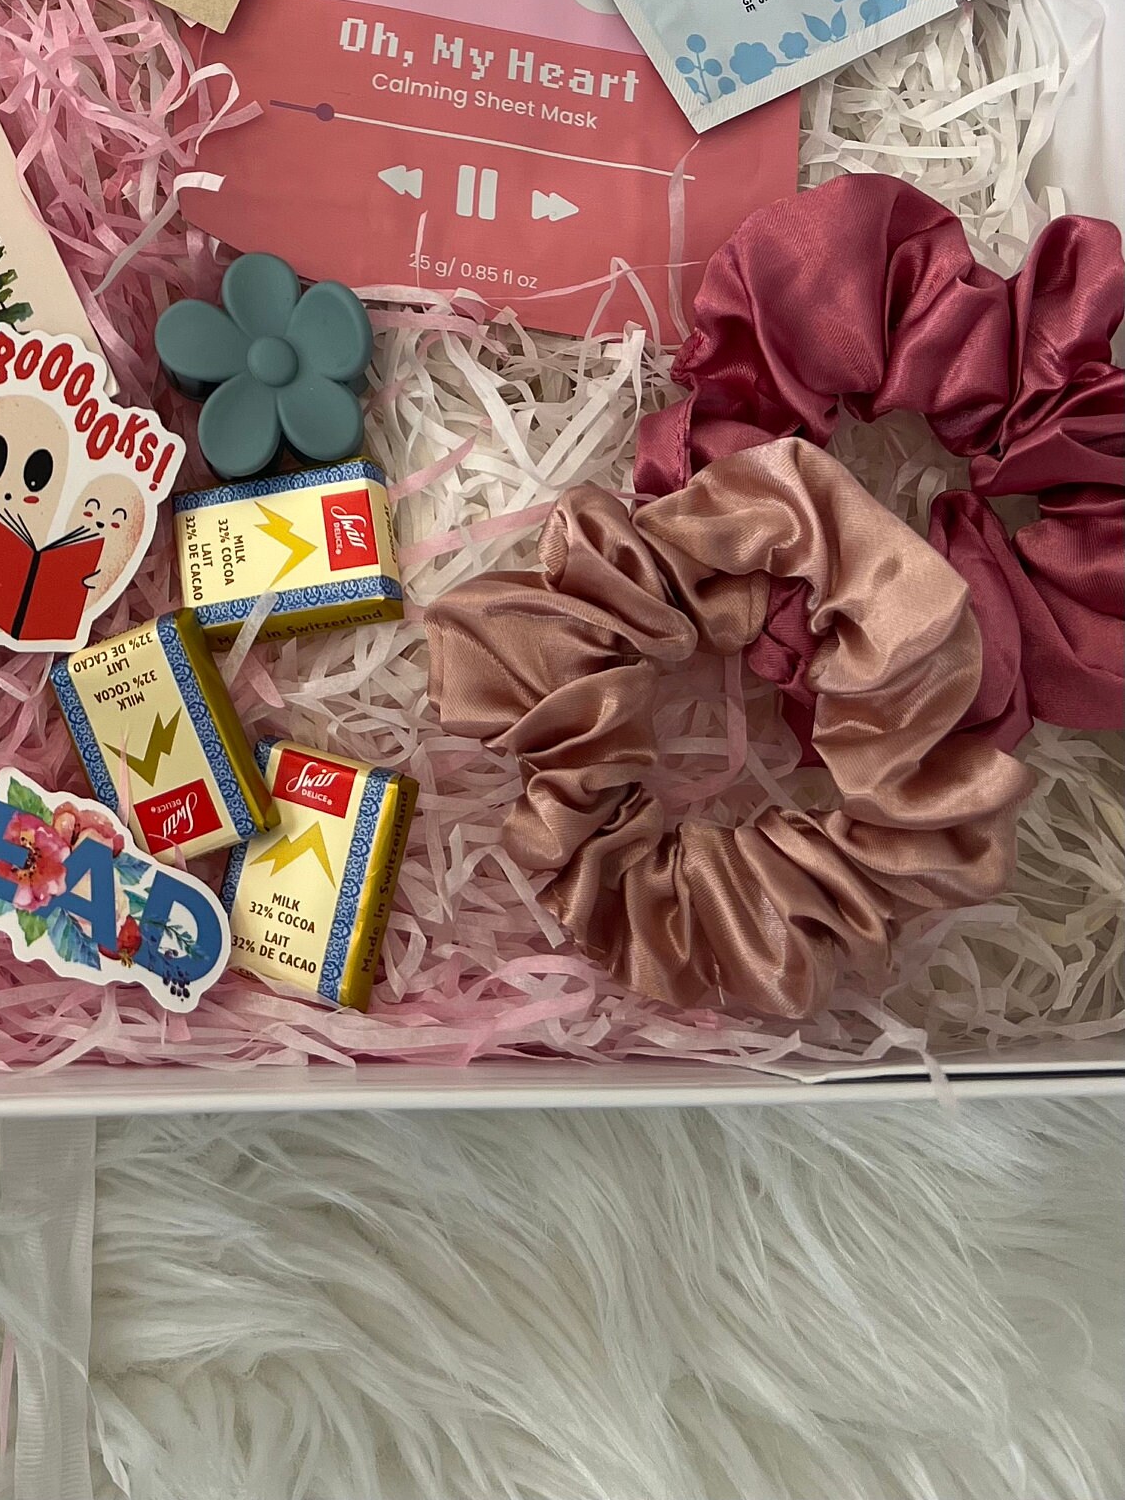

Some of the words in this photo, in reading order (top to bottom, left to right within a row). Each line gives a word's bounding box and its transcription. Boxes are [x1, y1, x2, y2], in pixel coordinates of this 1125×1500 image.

[339, 17, 413, 66] Oh,
[432, 33, 494, 80] My
[507, 48, 639, 102] Heart
[372, 73, 468, 108] Calming
[474, 85, 535, 118] Sheet
[541, 101, 598, 130] Mask
[461, 262, 498, 282] 0.85
[503, 269, 512, 284] fl
[517, 275, 538, 289] oz
[185, 515, 198, 541] 32%
[218, 518, 231, 544] 32%
[330, 505, 367, 551] Swiss
[188, 543, 199, 560] DE
[201, 543, 214, 567] LAIT
[233, 534, 246, 564] MILK
[221, 547, 235, 587] COCOA
[190, 564, 204, 601] CACAO
[286, 609, 384, 635] Switzerland
[111, 643, 126, 657] DE
[129, 632, 154, 650] 32%
[73, 654, 109, 673] CACAO
[107, 658, 130, 676] LAIT
[132, 670, 158, 687] 32%
[94, 681, 131, 704] COCOA
[118, 691, 145, 711] MILK
[286, 762, 340, 792] Swiss
[162, 792, 198, 838] Swiss
[361, 931, 380, 973] Made
[380, 791, 408, 895] Switzerland
[271, 893, 300, 912] MILK
[249, 901, 274, 920] 32%
[278, 911, 316, 934] COCOA
[265, 930, 290, 948] LAIT
[232, 935, 255, 954] 32%
[259, 944, 275, 960] DE
[279, 950, 317, 974] CACAO
